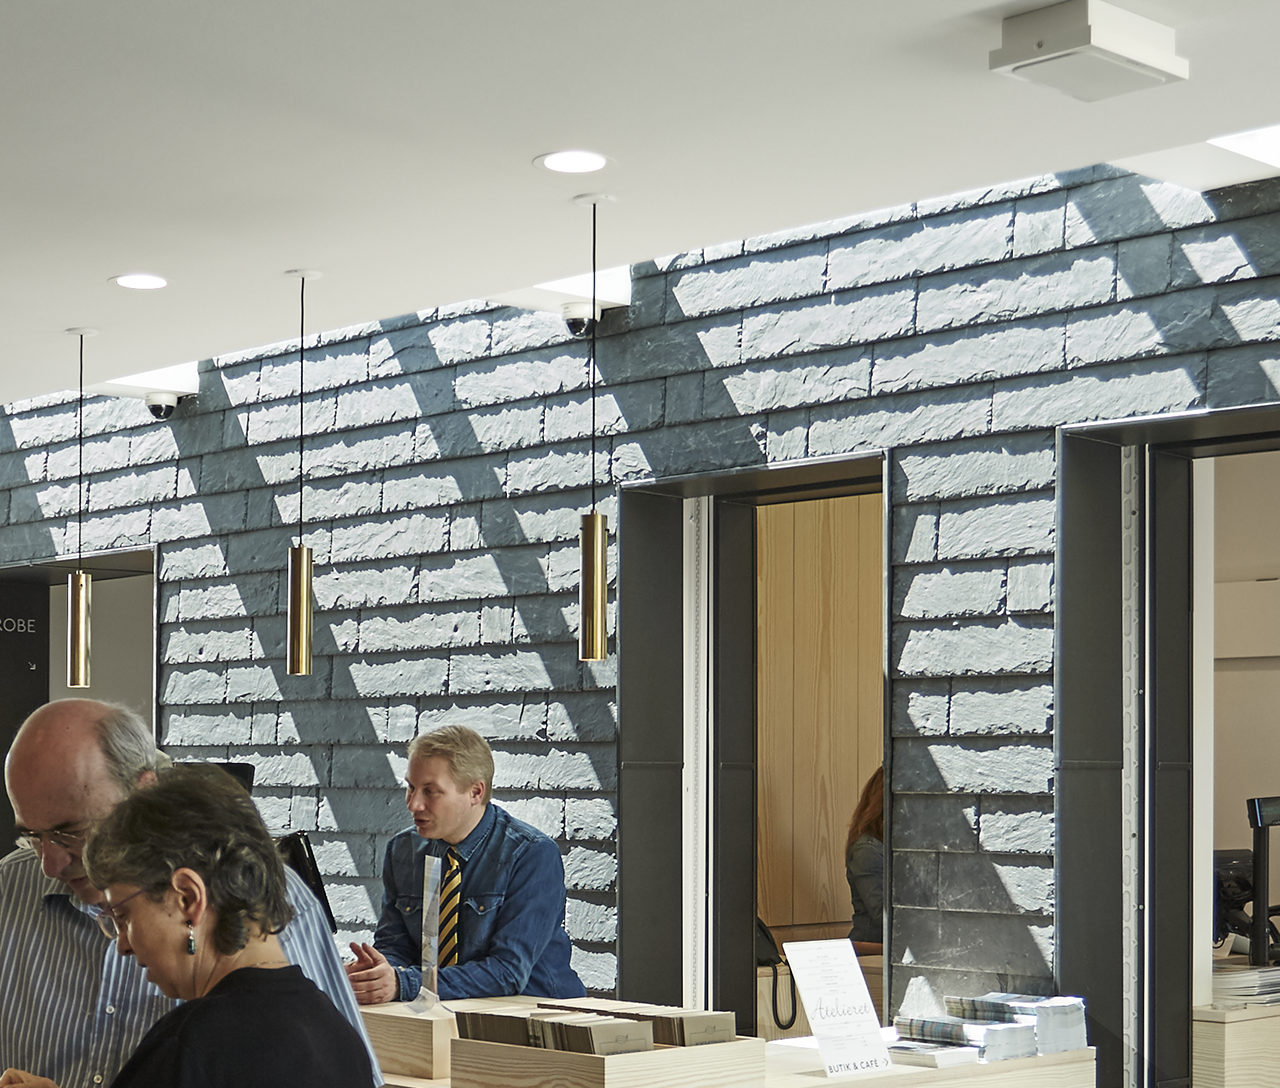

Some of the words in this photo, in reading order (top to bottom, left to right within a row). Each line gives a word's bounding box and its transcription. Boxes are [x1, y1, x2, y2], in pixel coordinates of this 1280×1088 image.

[811, 996, 871, 1020] Atelieret
[828, 1062, 852, 1074] BUTIK
[853, 1062, 859, 1071] &
